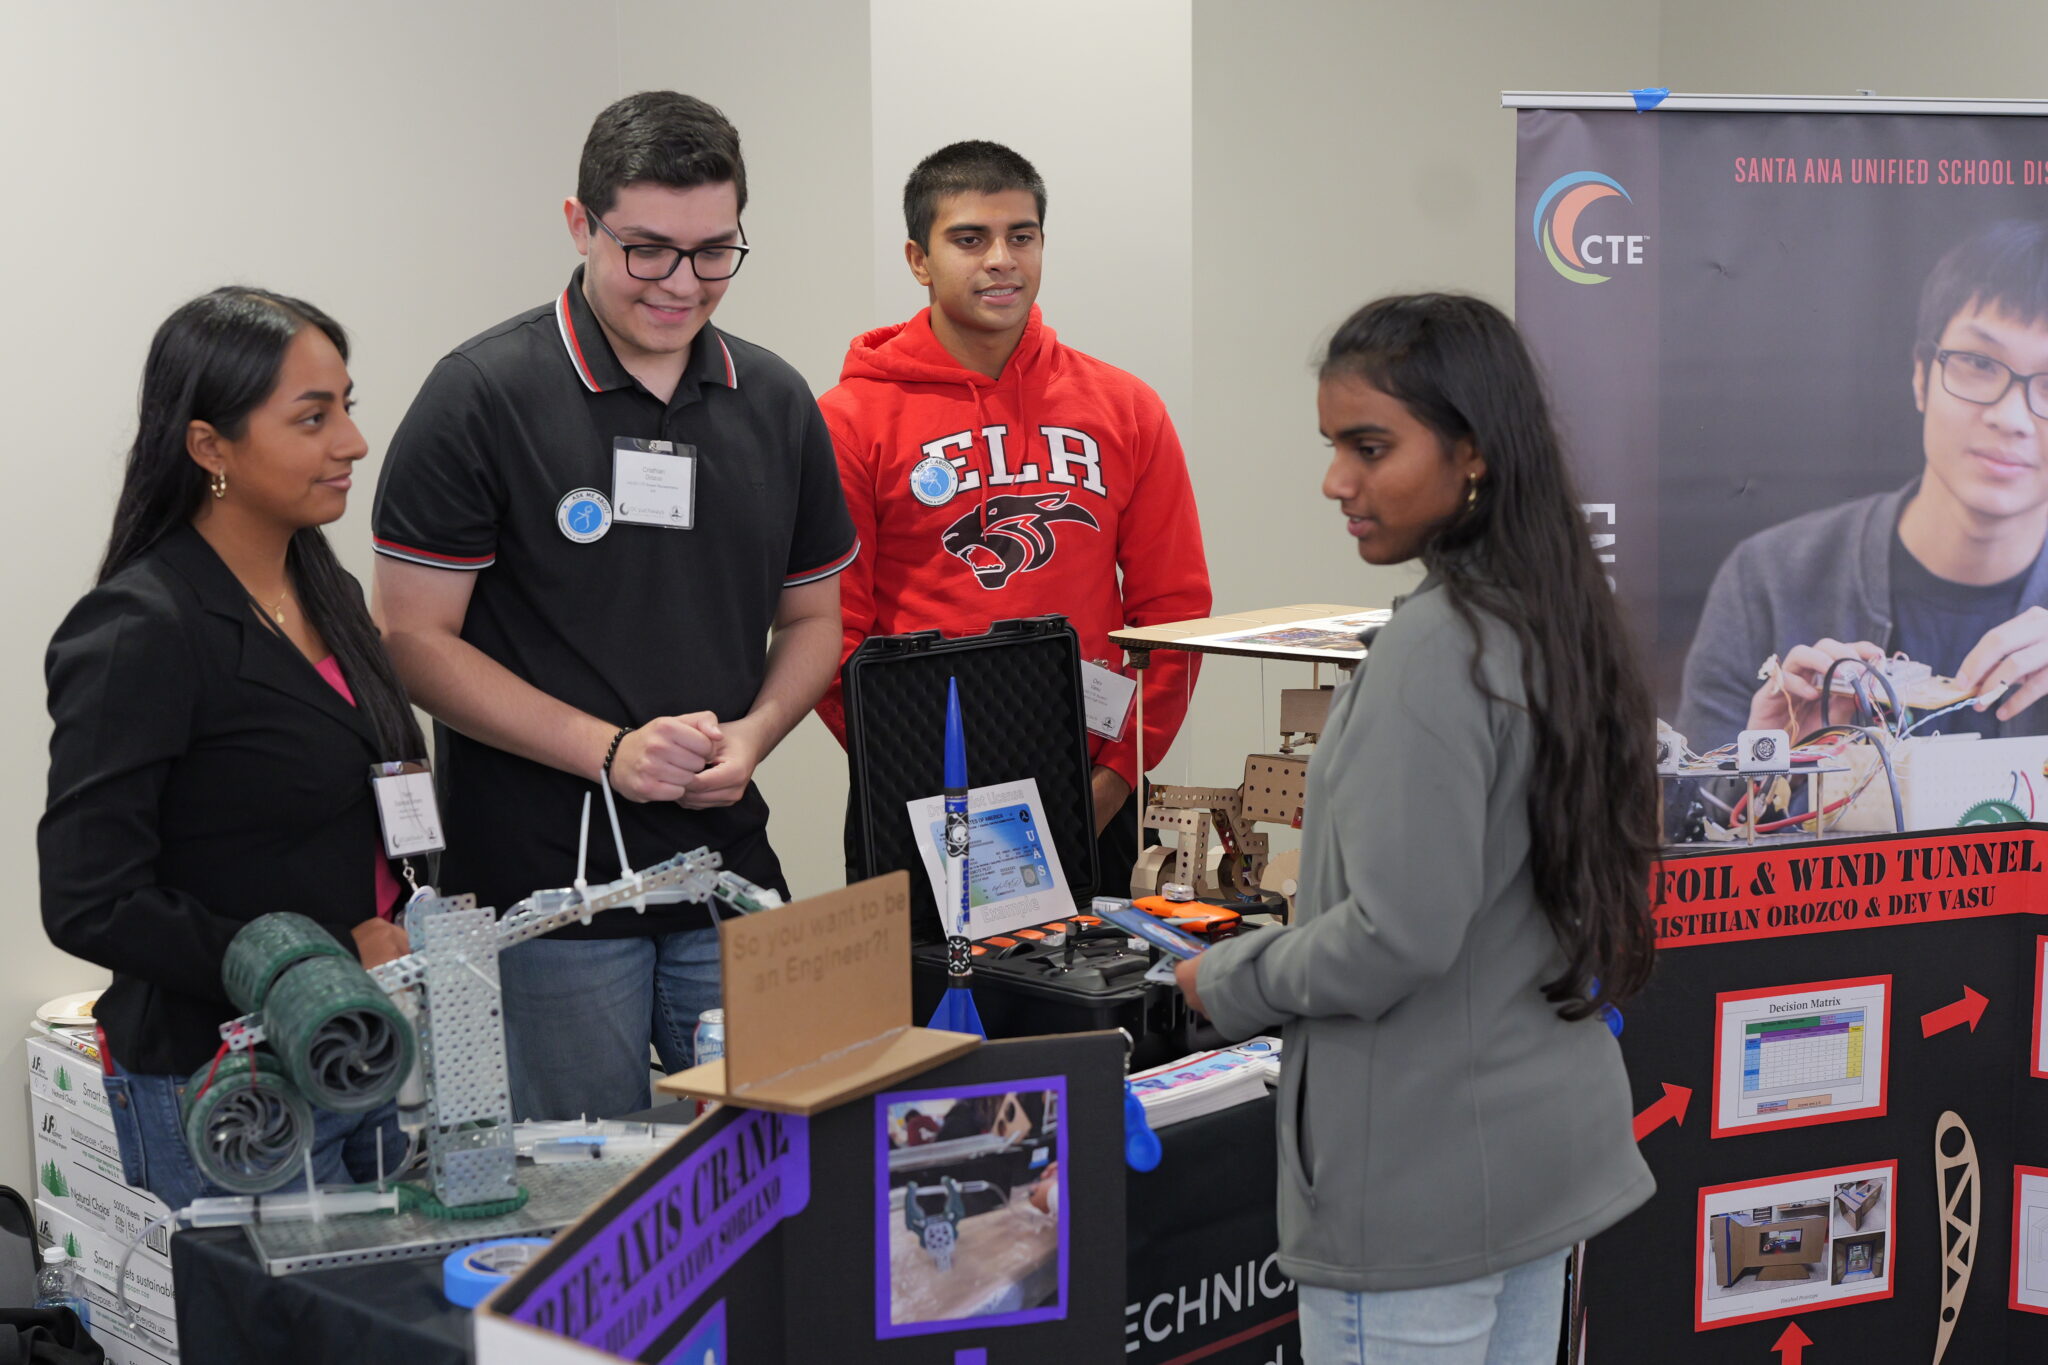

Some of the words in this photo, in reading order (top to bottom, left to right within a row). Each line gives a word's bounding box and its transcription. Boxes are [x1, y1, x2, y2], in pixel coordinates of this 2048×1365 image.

[1735, 157, 1797, 184] SANTA
[1804, 158, 1843, 184] ANA
[1852, 158, 1929, 185] UNIFIED
[1938, 159, 2014, 185] SCHOOL
[1580, 235, 1644, 265] CTE
[919, 424, 1108, 499] ELR
[1750, 861, 1777, 897] &
[1787, 851, 1887, 892] WIND
[1897, 839, 2043, 883] TUNNEL
[1767, 898, 1858, 928] OROZCO
[1864, 896, 1881, 919] &
[1888, 891, 1932, 916] DEV
[1938, 886, 1996, 911] VASU
[733, 931, 759, 961] So
[767, 921, 804, 957] you
[810, 908, 856, 938] want
[861, 901, 878, 920] to
[885, 890, 906, 916] be
[755, 970, 779, 995] an
[1769, 1001, 1809, 1014] Decision
[1810, 996, 1841, 1009] Matrix
[82, 1081, 101, 1102] Smart
[692, 1109, 790, 1227] CRANE
[70, 1186, 91, 1207] Natural
[91, 1196, 110, 1217] Choice
[94, 1249, 114, 1271] Smart
[1124, 1250, 1297, 1354] ECHNIC
